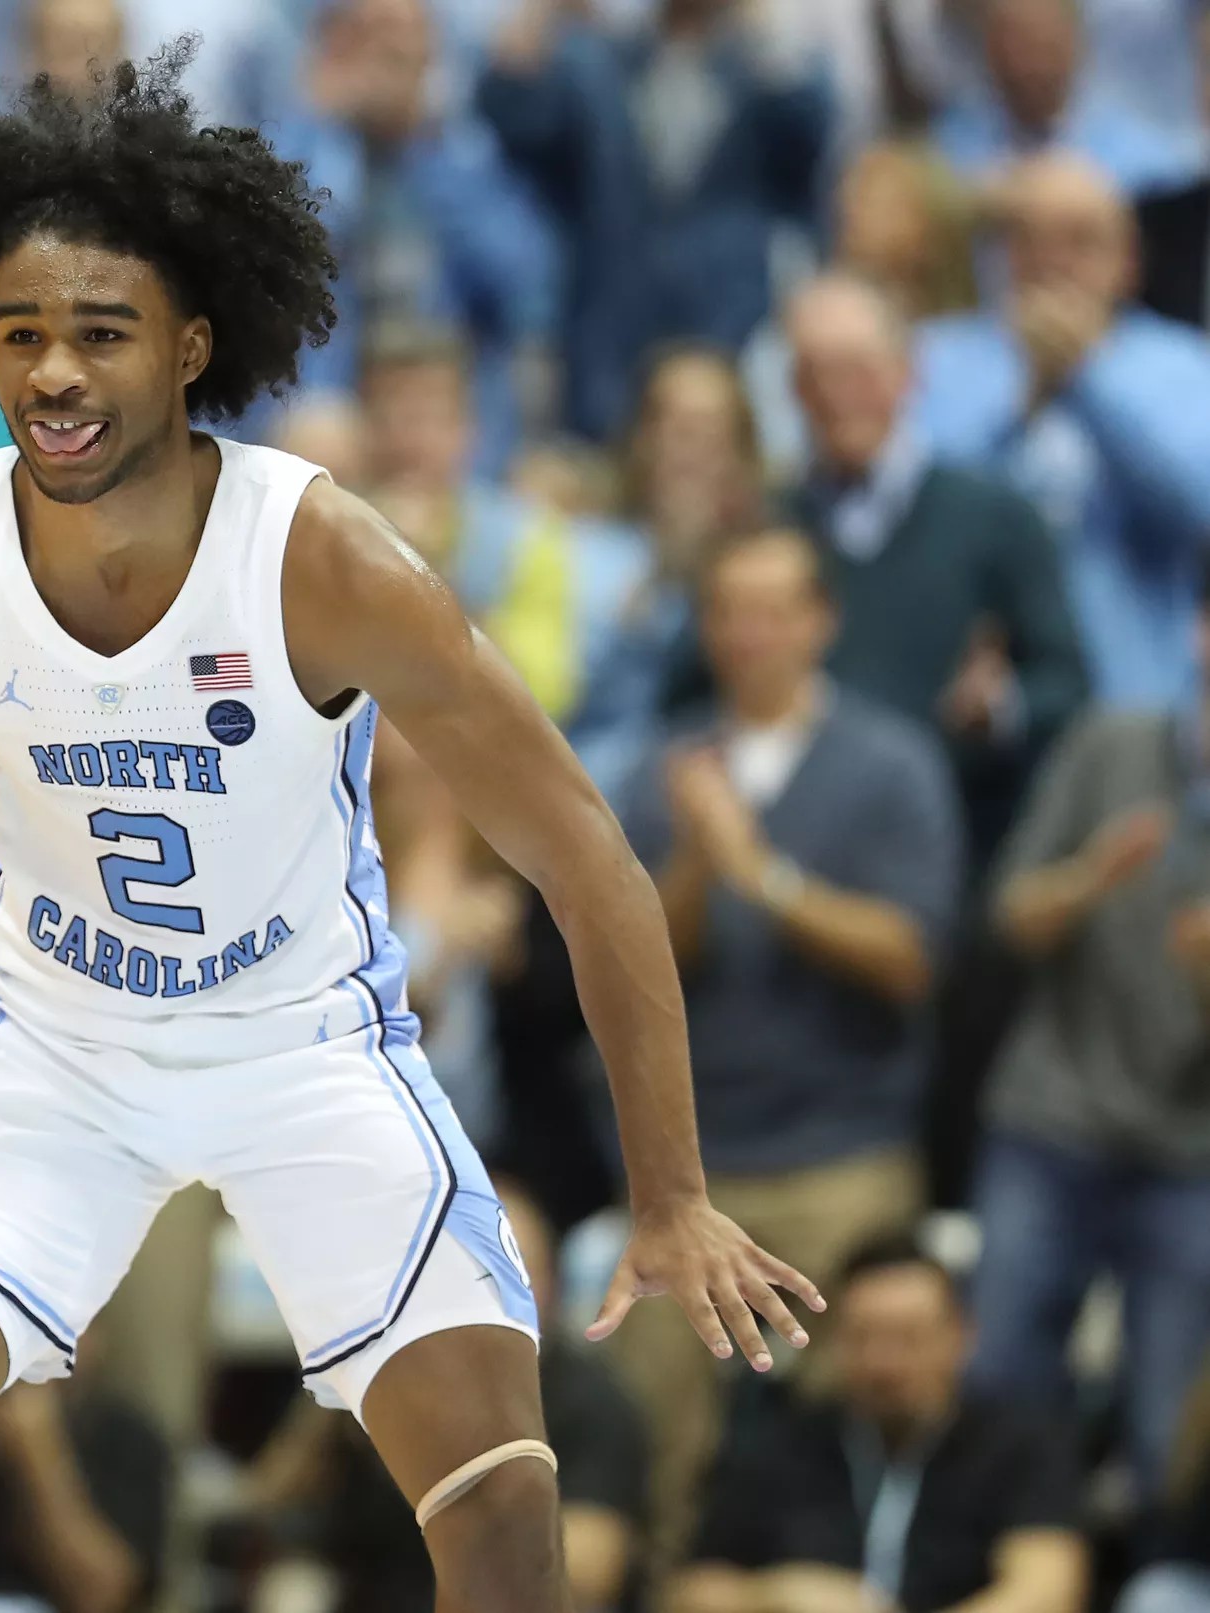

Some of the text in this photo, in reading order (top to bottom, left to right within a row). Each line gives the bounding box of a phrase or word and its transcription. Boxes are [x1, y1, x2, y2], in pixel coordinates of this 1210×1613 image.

[212, 712, 250, 726] ACC
[29, 740, 227, 794] NORTH
[88, 807, 204, 934] 2
[27, 895, 294, 998] CAROLINA
